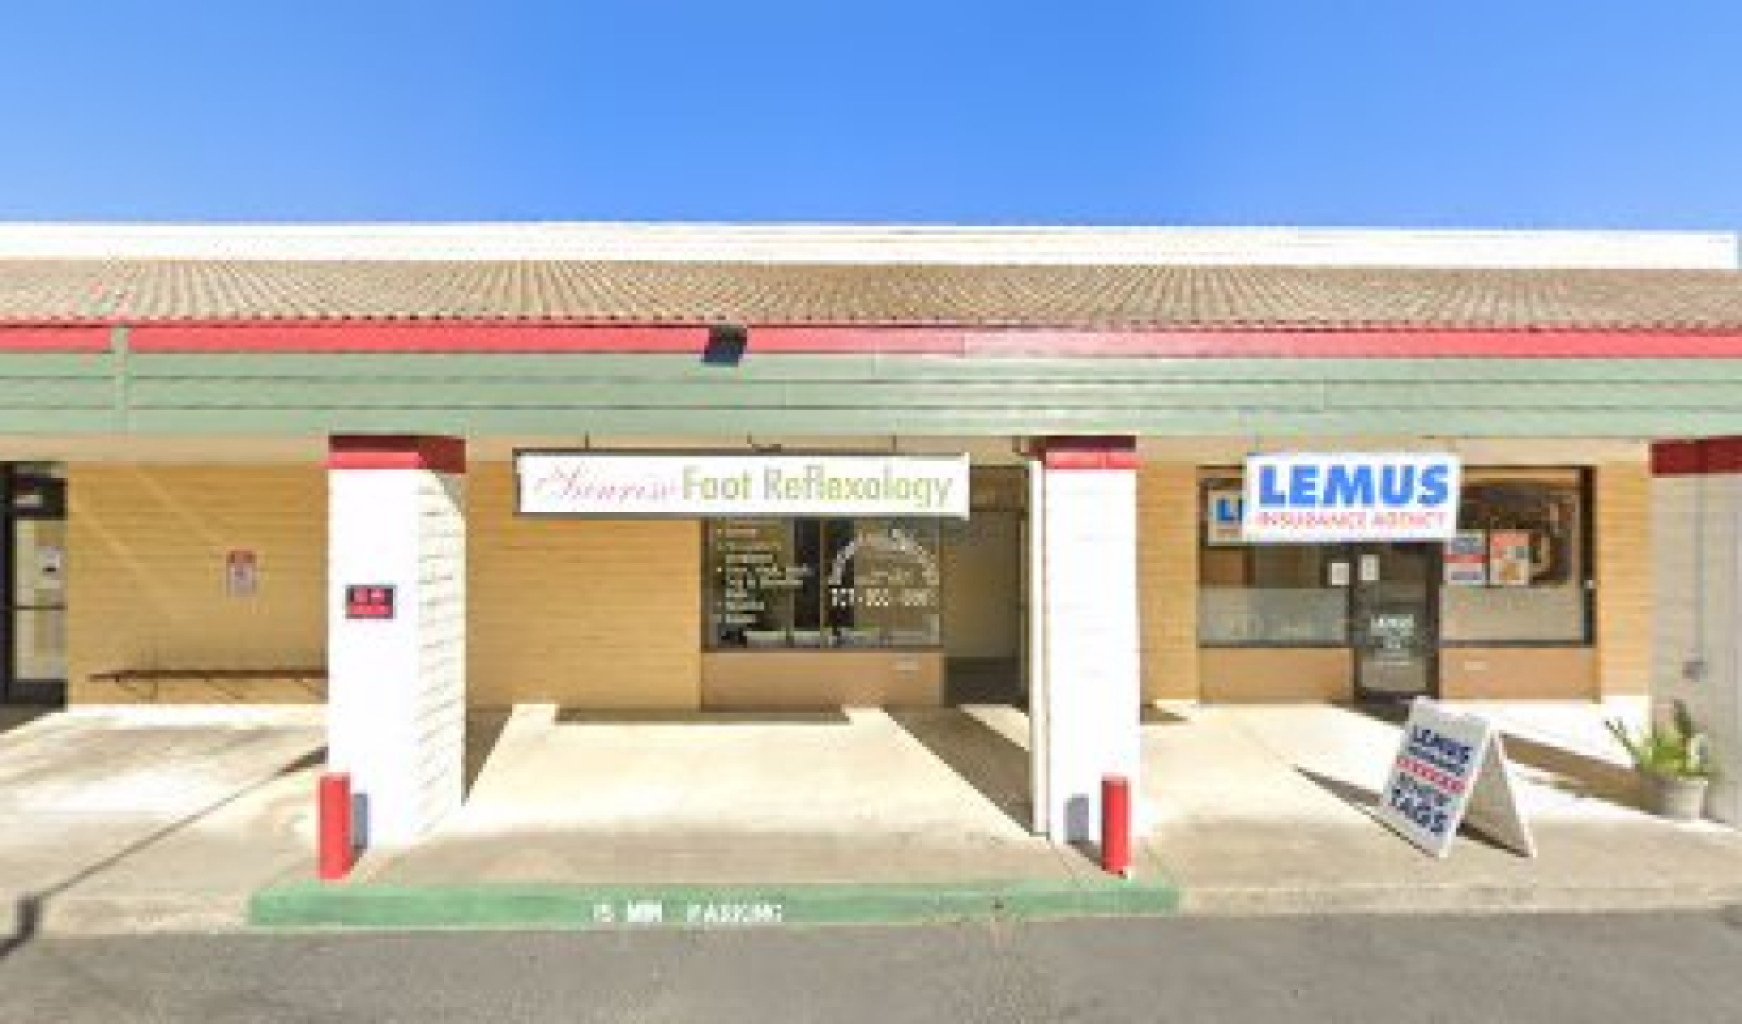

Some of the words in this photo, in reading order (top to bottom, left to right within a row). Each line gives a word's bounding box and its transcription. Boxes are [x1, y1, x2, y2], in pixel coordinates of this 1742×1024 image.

[682, 464, 752, 501] Foot
[763, 463, 953, 508] Reflexology
[1258, 463, 1450, 507] LEMUS
[1256, 511, 1367, 530] INSURANCE
[1373, 511, 1449, 530] AGENCY
